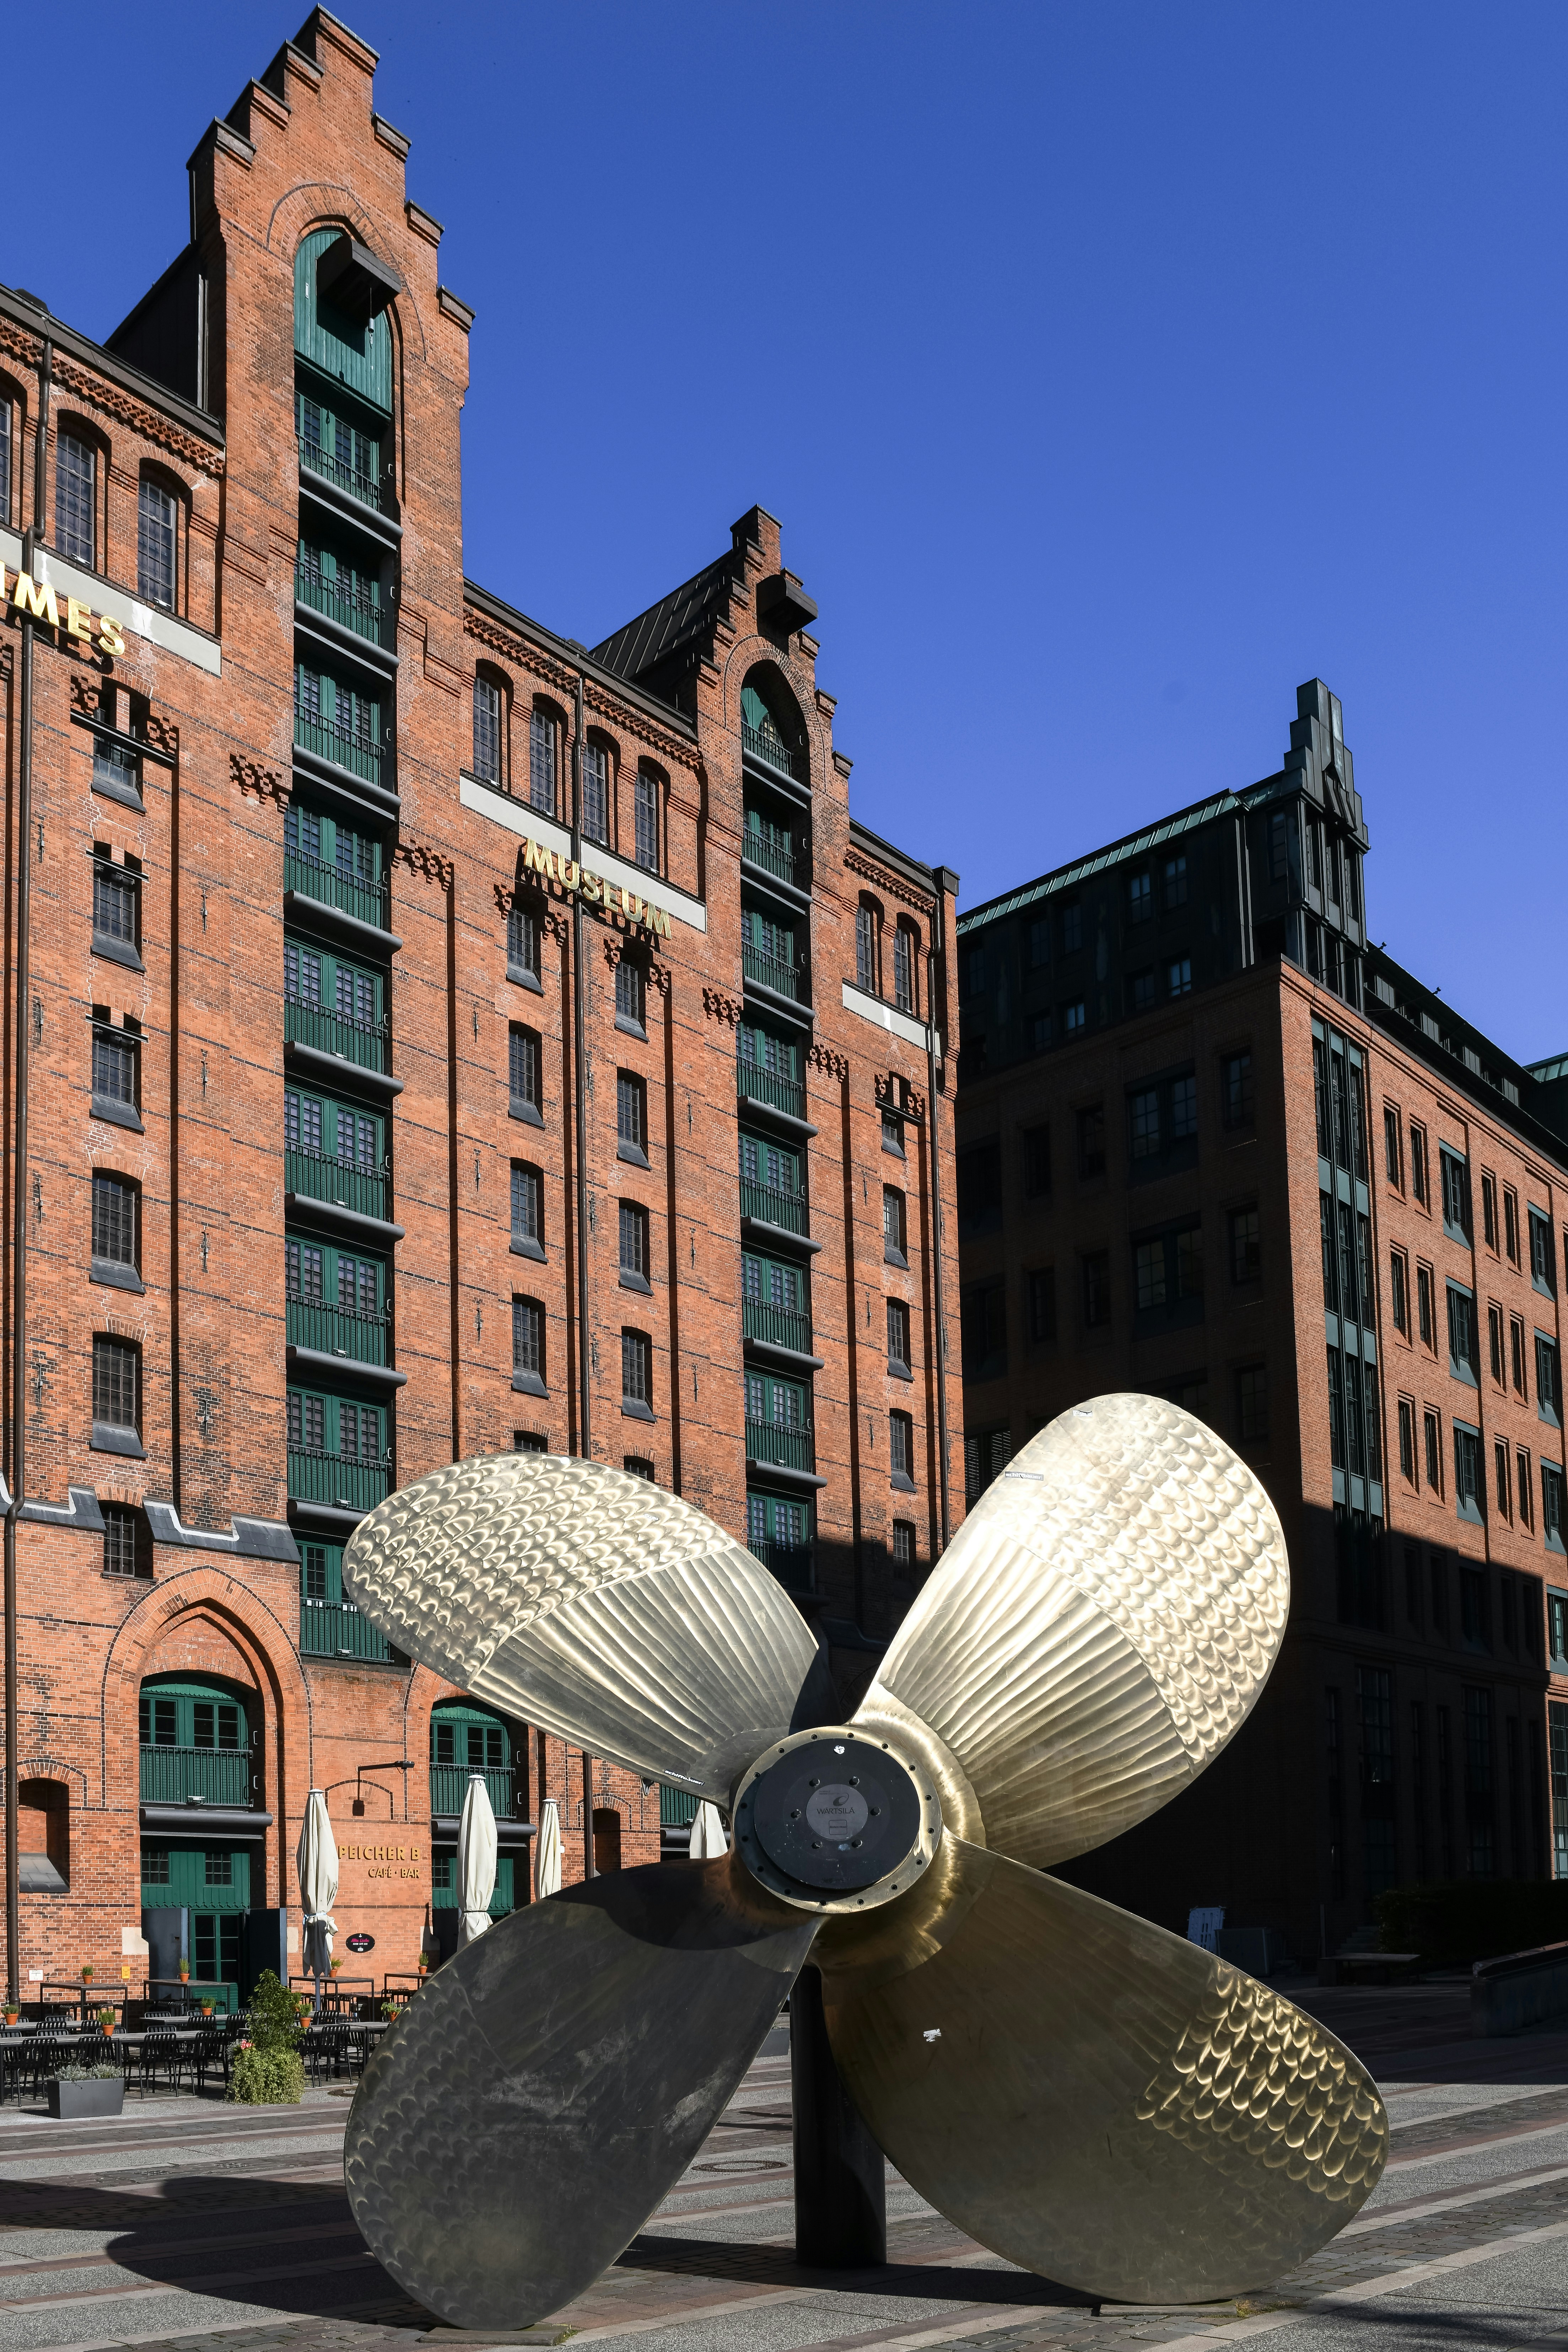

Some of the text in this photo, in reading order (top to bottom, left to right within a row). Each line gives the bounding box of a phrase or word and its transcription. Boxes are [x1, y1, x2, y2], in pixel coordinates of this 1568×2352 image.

[524, 838, 672, 941] MUSEUM
[411, 1847, 420, 1861] B
[368, 1865, 419, 1878] CAFÉ BAR
